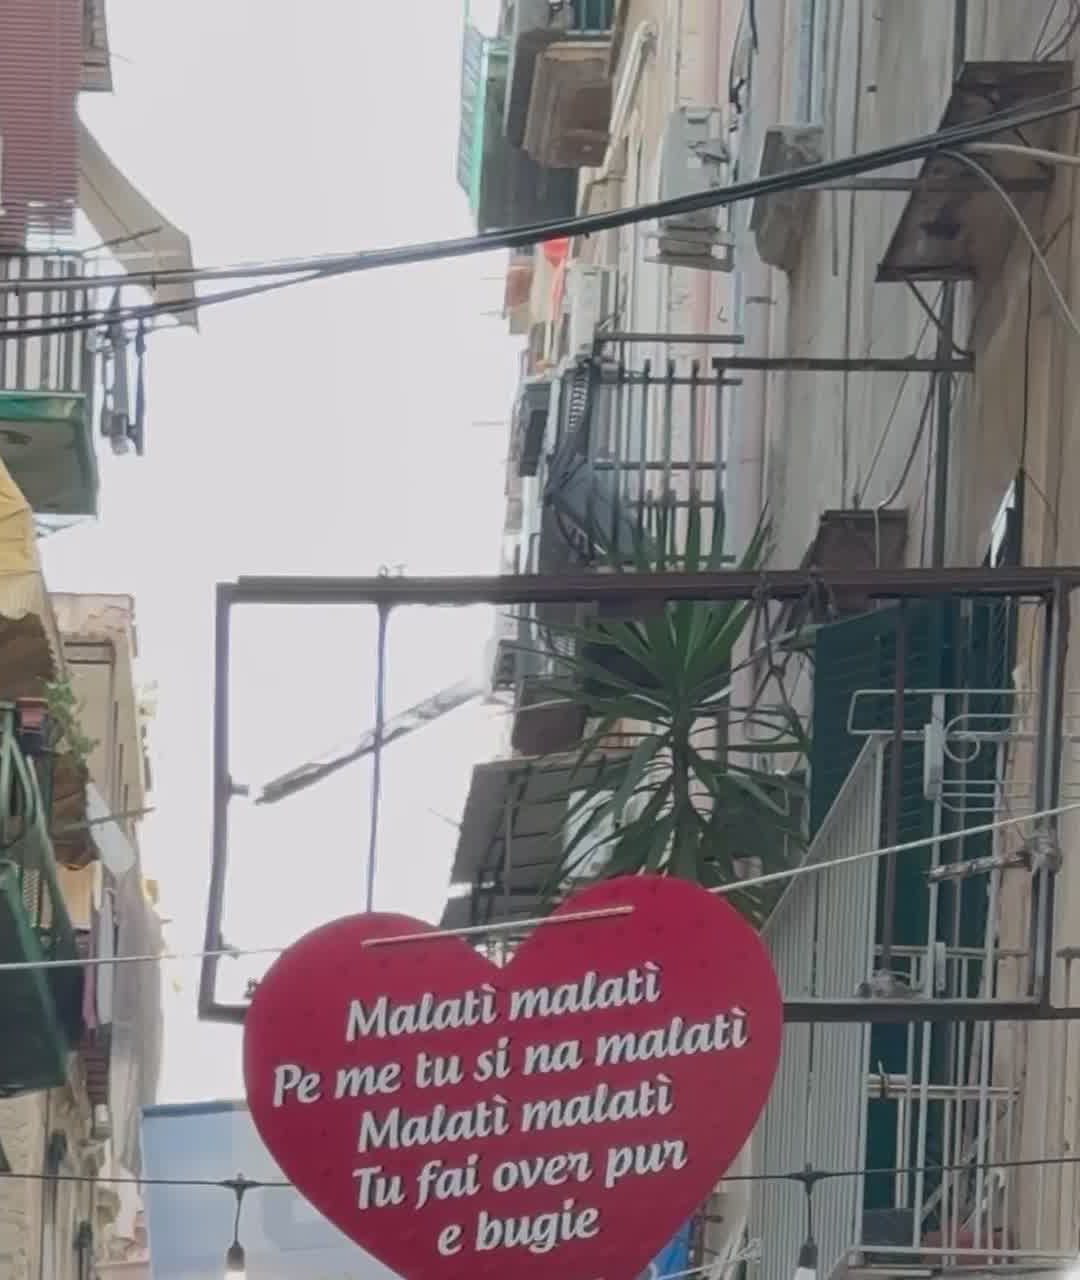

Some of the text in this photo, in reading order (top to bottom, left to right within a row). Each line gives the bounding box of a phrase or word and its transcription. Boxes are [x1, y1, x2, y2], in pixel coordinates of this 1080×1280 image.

[346, 961, 661, 1042] Malatì malatì
[273, 1008, 749, 1107] Pe me tu si na malatì
[357, 1074, 673, 1153] Malatì malatì
[352, 1138, 687, 1210] Tu fai over pur
[437, 1198, 600, 1257] e bugie
